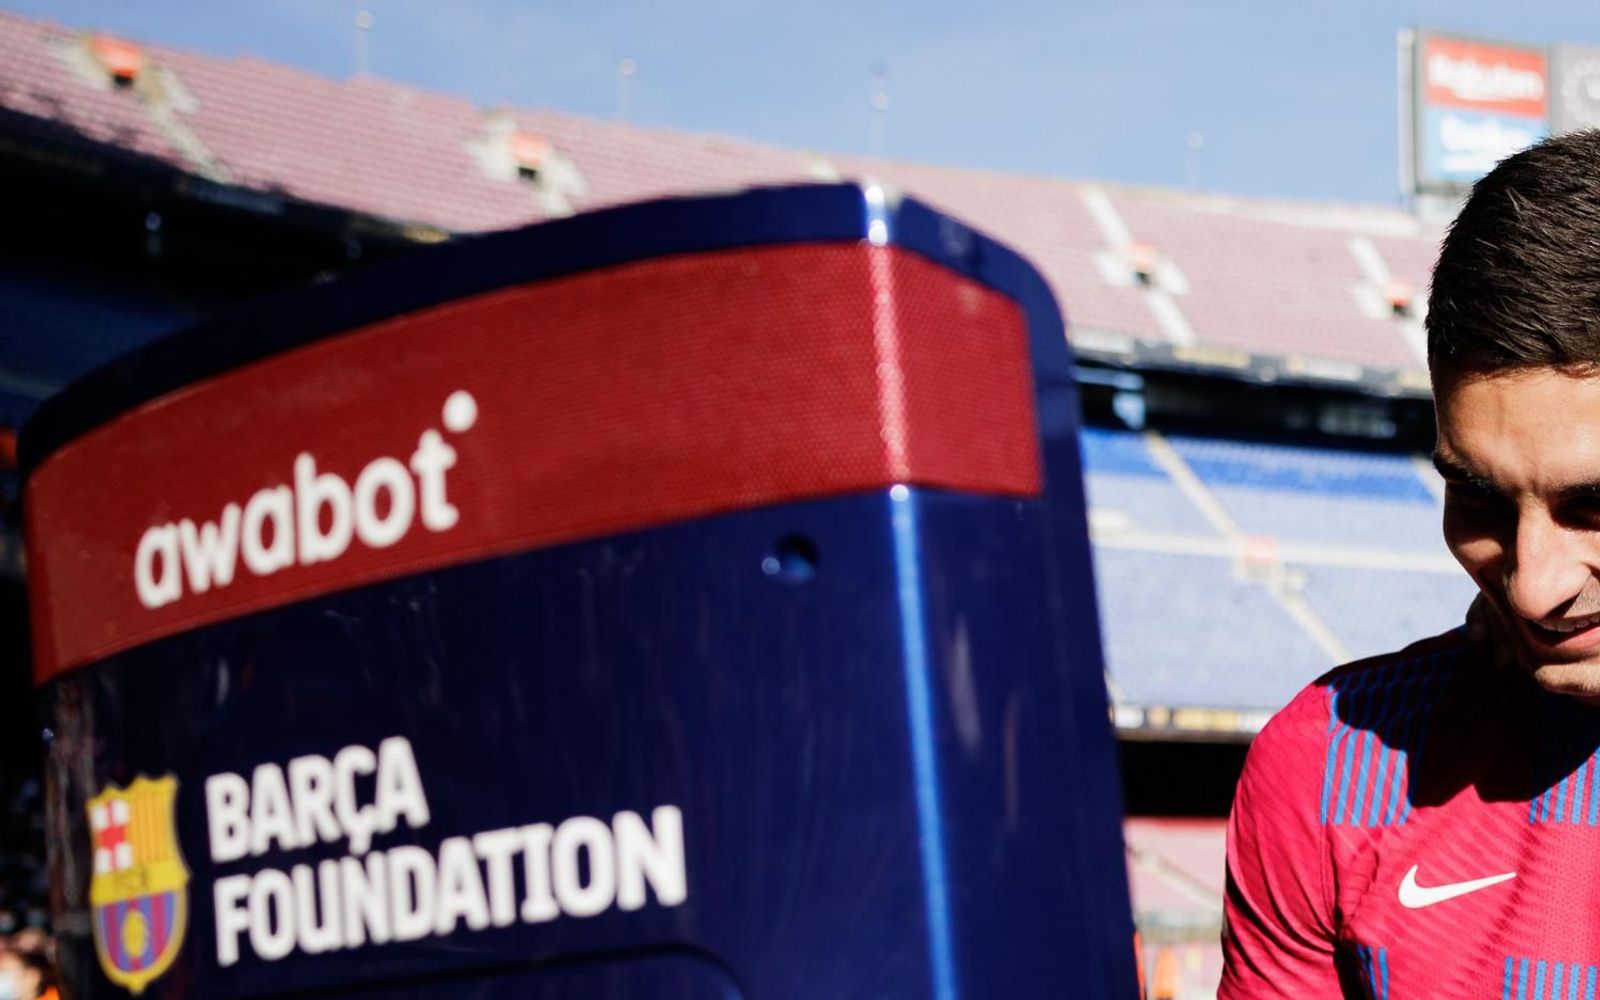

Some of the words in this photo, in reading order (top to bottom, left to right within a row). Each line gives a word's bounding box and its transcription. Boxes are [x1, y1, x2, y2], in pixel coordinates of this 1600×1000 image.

[133, 427, 460, 609] awabot
[205, 735, 431, 863] BARÇA
[212, 804, 688, 967] FOUNDATION
